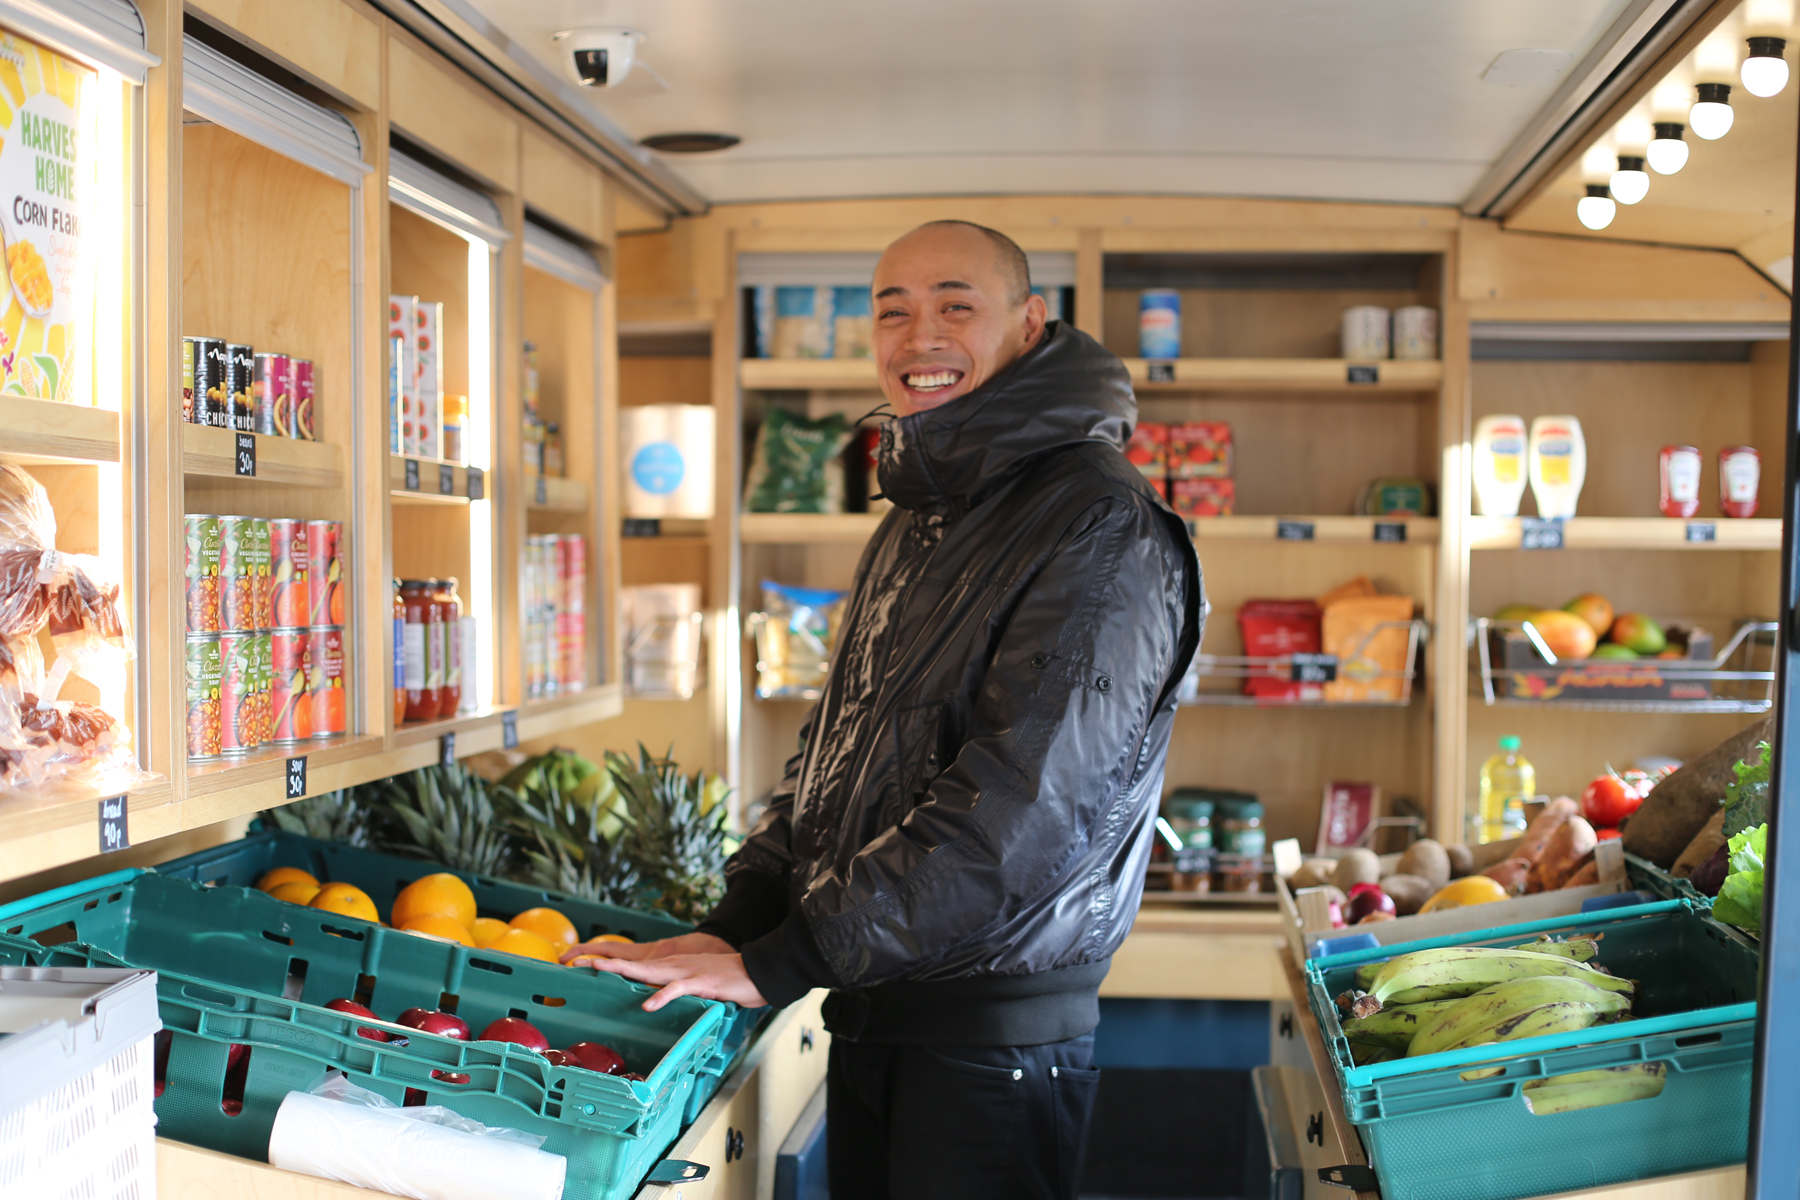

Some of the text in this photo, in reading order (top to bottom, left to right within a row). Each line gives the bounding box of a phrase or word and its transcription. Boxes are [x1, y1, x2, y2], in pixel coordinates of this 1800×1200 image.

[21, 109, 79, 163] HARVES
[35, 155, 75, 202] HOME
[13, 194, 48, 228] CORN
[206, 347, 227, 366] Nap
[206, 412, 227, 427] CHIC
[239, 451, 253, 475] 30p
[289, 774, 304, 796] 50p
[102, 796, 123, 819] bread
[103, 821, 122, 849] 90p
[267, 1023, 318, 1044] TESCO
